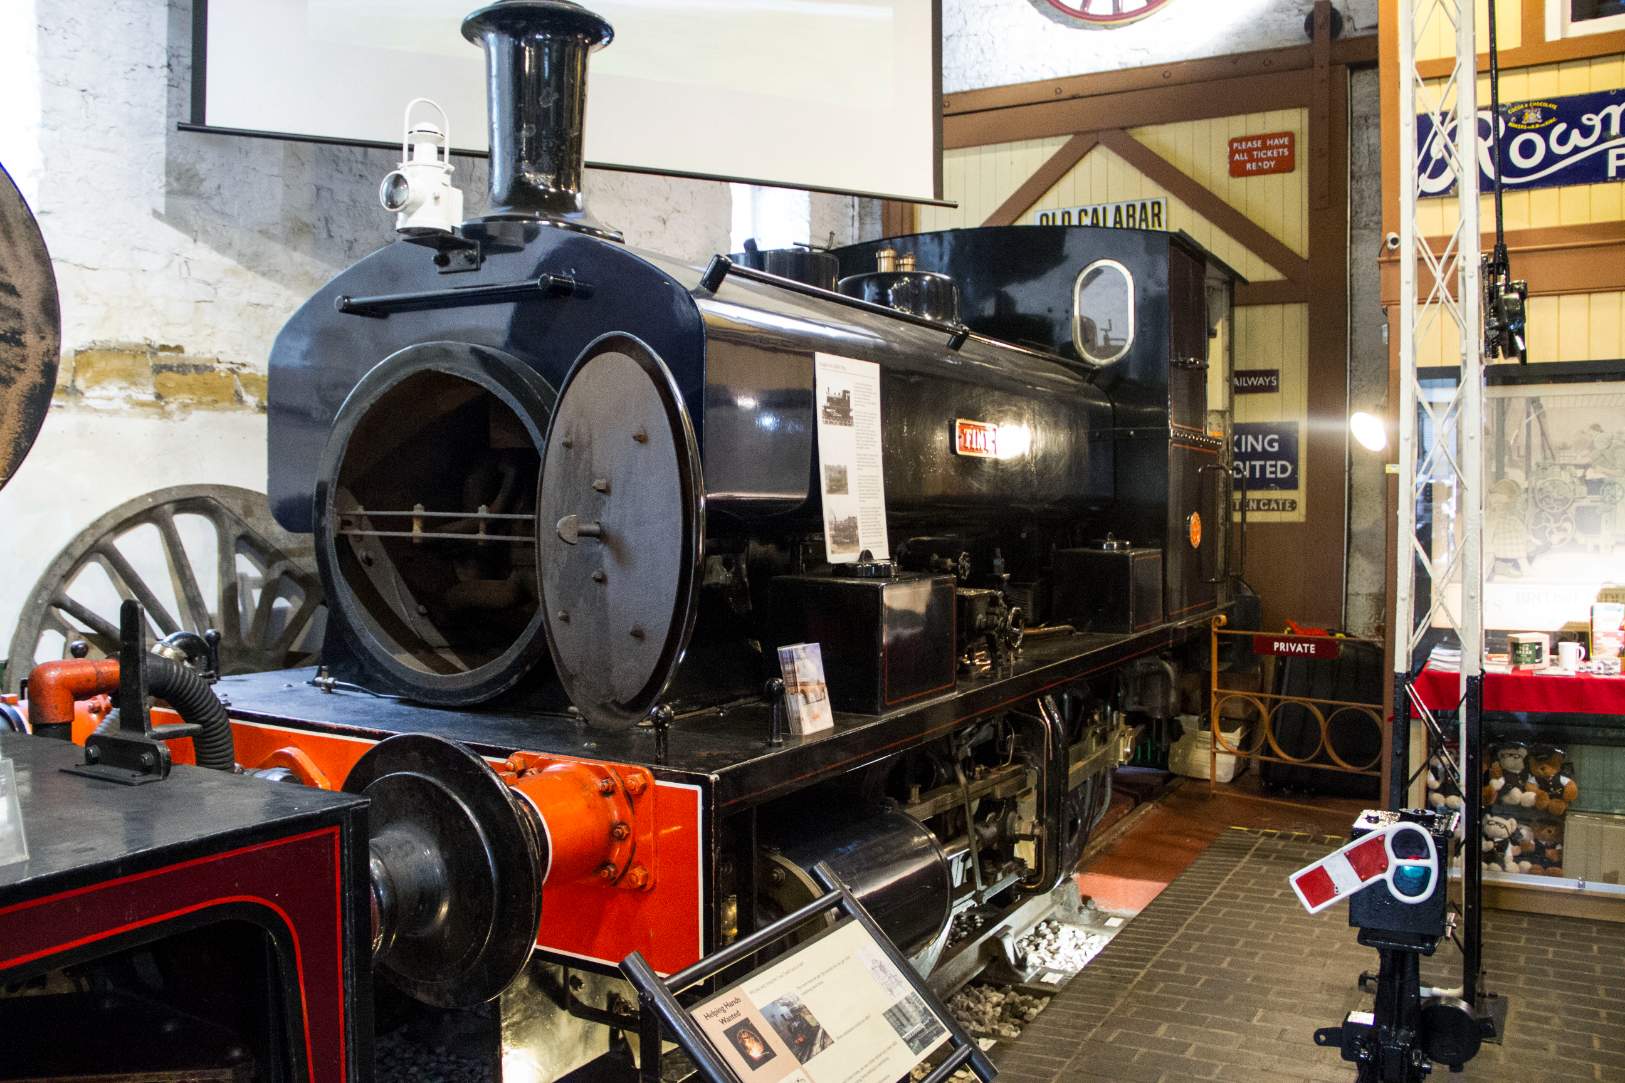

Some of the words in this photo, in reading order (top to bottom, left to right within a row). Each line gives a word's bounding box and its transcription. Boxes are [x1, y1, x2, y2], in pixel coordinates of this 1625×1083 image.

[1233, 140, 1262, 149] PLEASE
[1266, 136, 1289, 146] HAVE
[1234, 152, 1248, 160] ALL
[1253, 148, 1289, 159] TICKETS
[1079, 200, 1162, 229] CALABAR
[1233, 499, 1292, 511] TNGATE
[1273, 642, 1316, 653] PRIVATE
[703, 1005, 727, 1021] Helping
[722, 997, 742, 1010] Hands
[718, 1010, 742, 1025] Wanted
